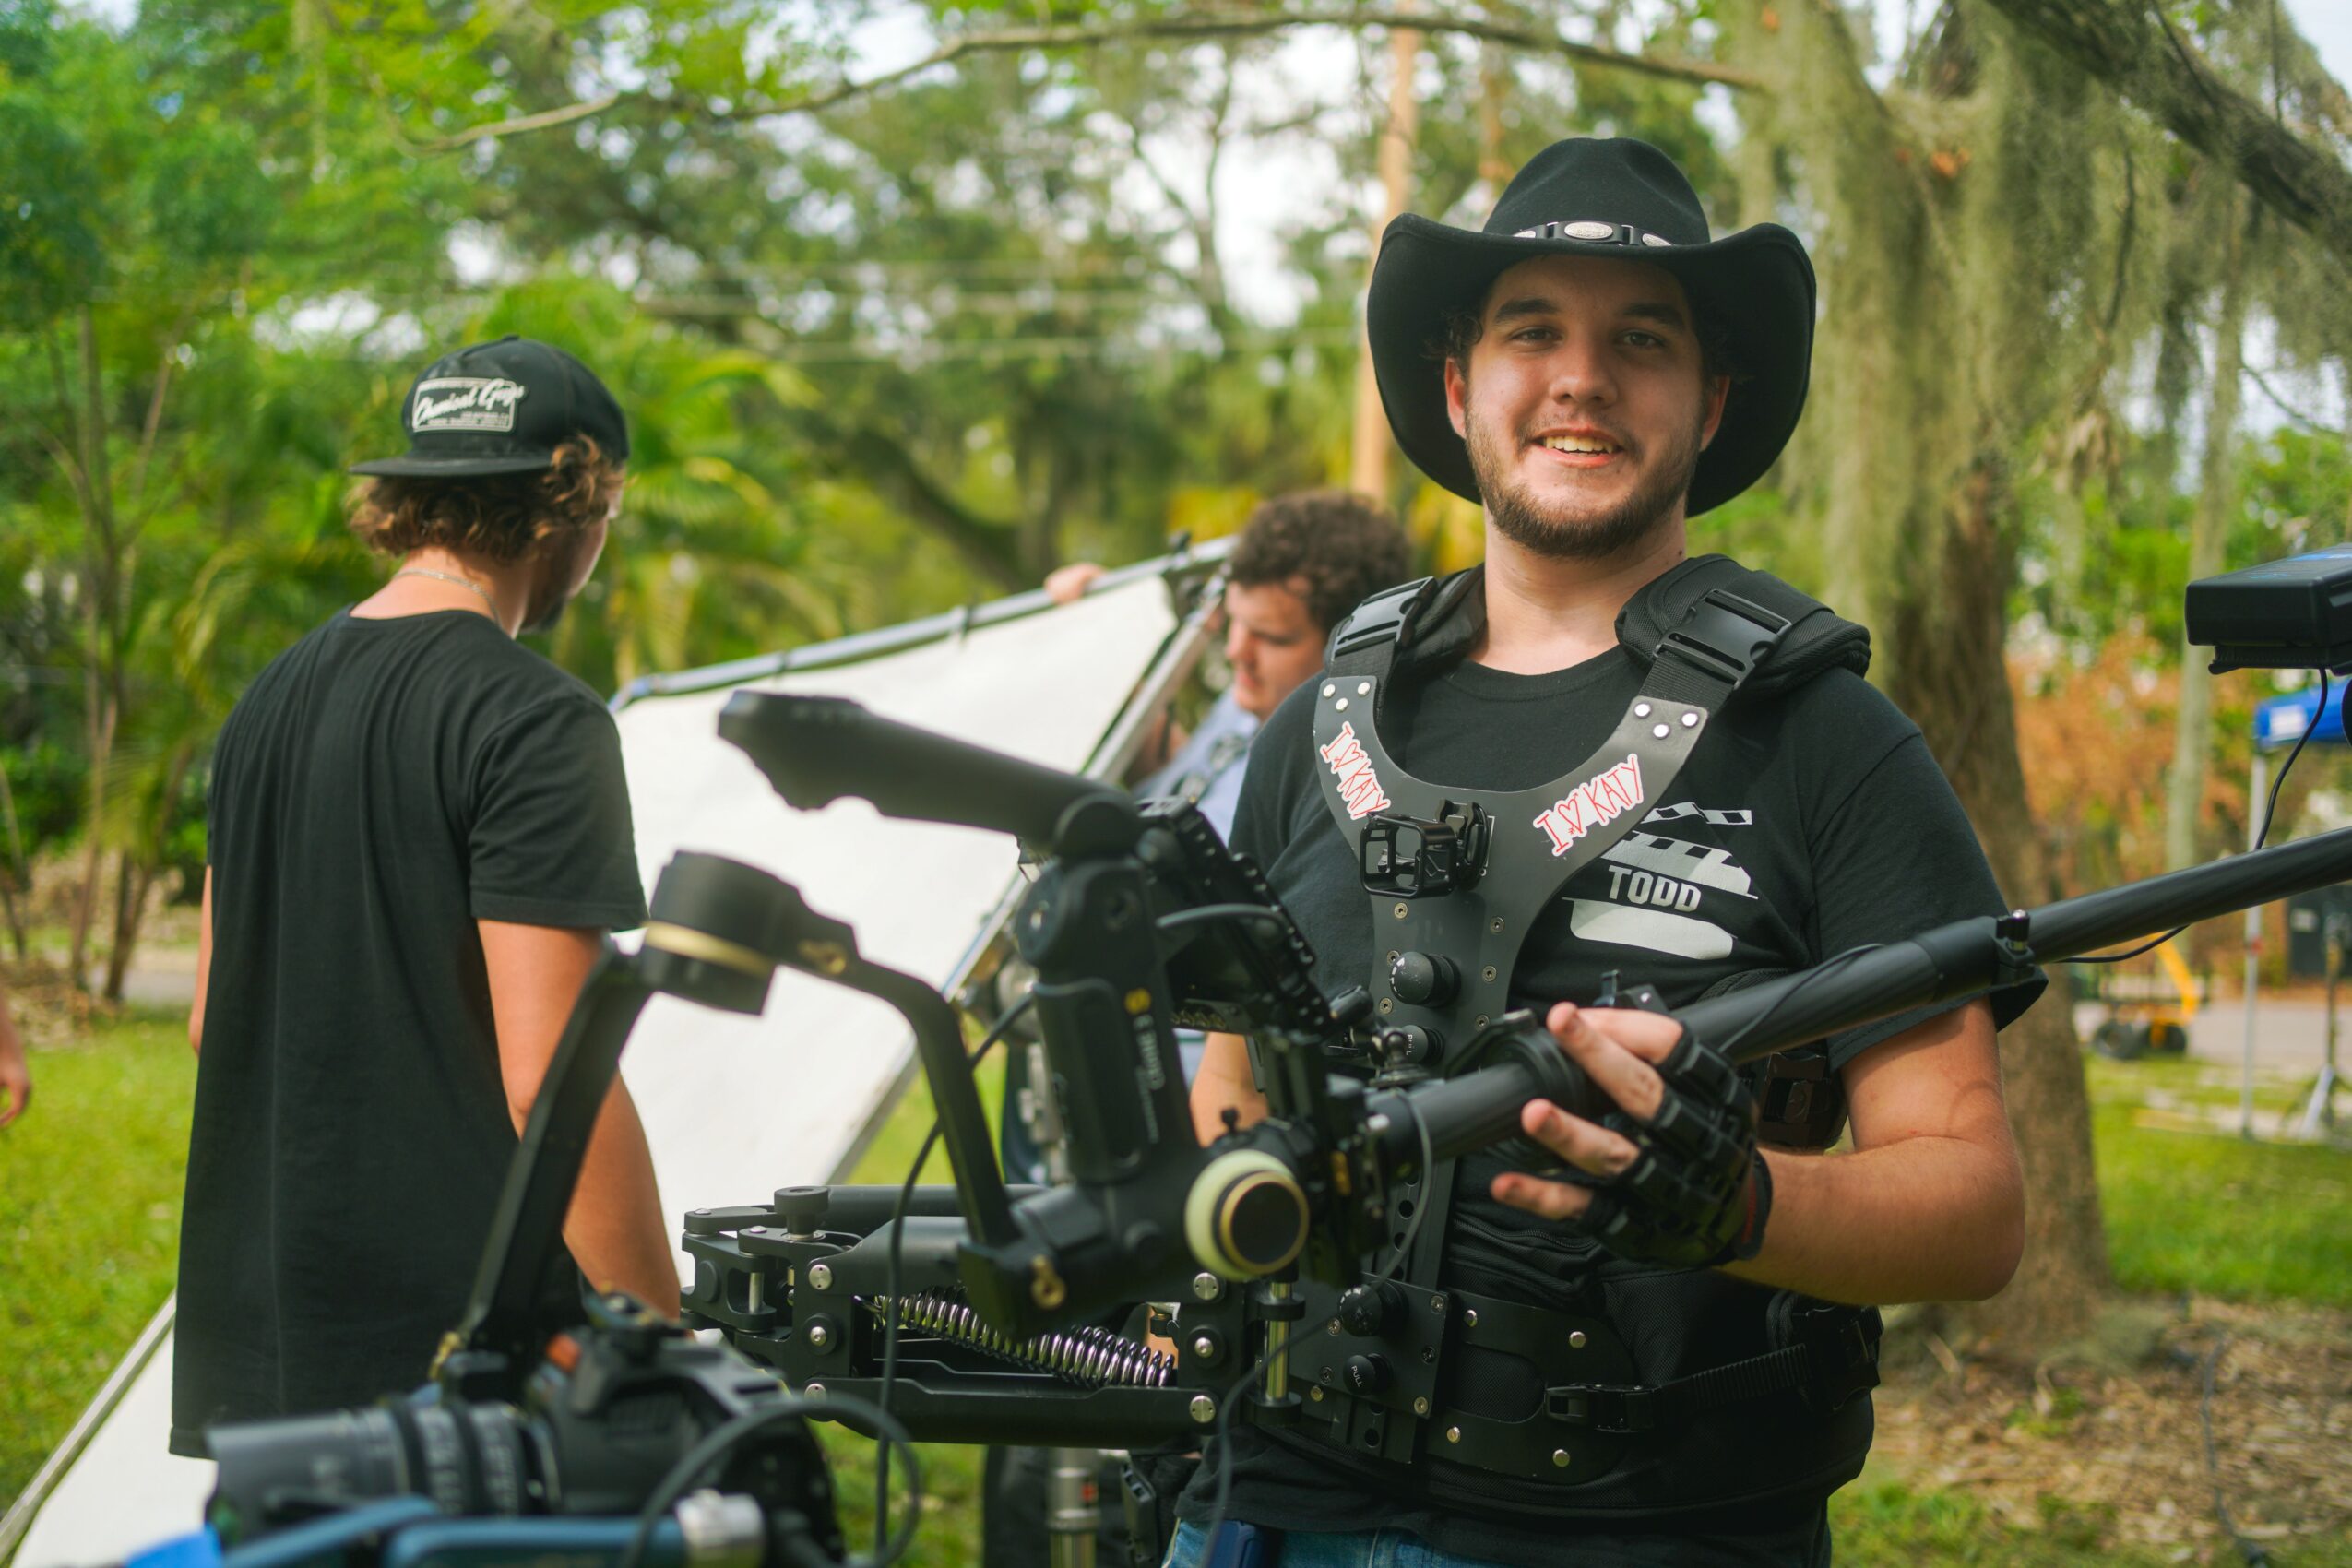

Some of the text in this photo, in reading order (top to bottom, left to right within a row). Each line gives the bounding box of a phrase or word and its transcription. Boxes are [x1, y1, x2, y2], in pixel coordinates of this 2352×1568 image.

[1339, 761, 1388, 817] KATY
[1582, 756, 1640, 823] KATY
[1608, 864, 1702, 913] TODD
[1350, 1365, 1363, 1388] PULL
